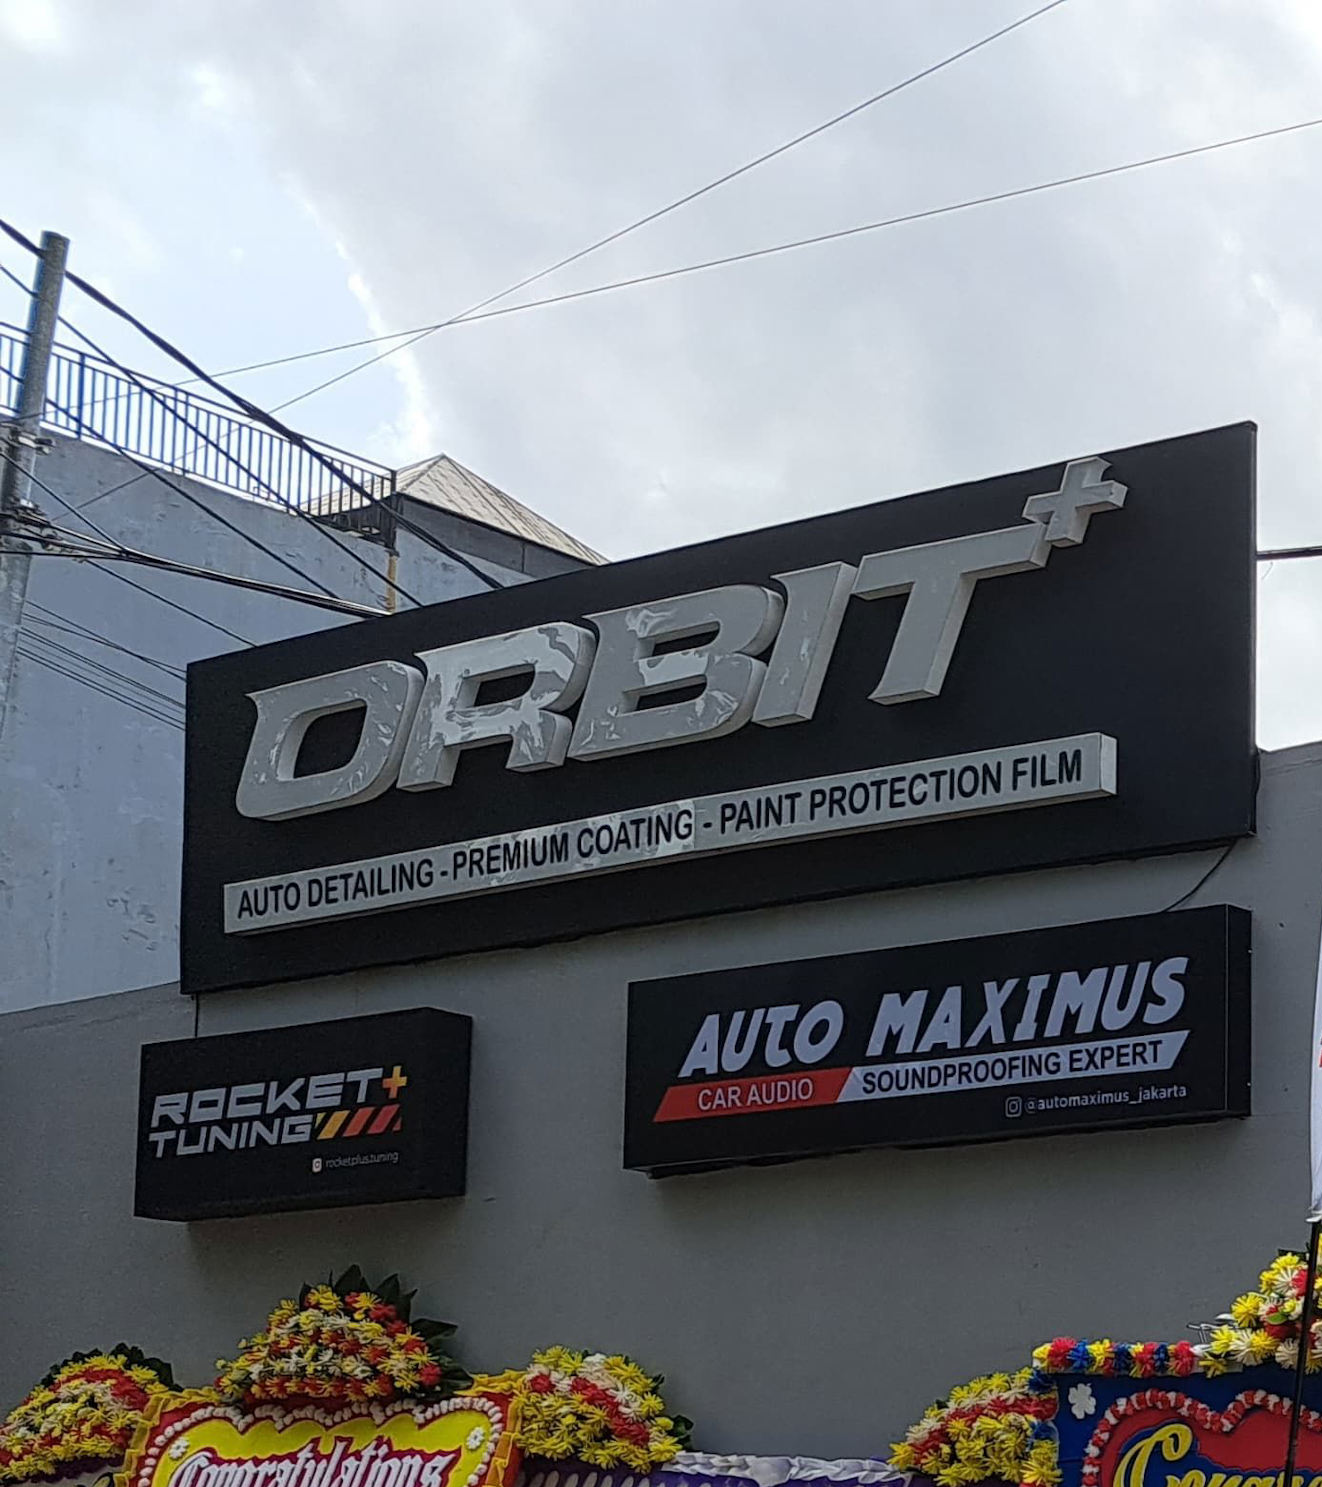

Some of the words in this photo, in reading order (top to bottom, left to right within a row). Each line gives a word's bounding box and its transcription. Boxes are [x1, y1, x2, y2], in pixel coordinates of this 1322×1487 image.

[237, 882, 299, 920] AUTO
[307, 858, 435, 908] DETAILING
[452, 832, 569, 882] PREMIUM
[577, 808, 693, 858] COATING
[720, 791, 802, 835] PAINT
[810, 760, 1001, 821] PROTECTION
[1011, 748, 1083, 792] FILM
[677, 999, 845, 1079] AUTO
[865, 956, 1190, 1057] MAXIMUS
[698, 1085, 741, 1111] CAR
[745, 1077, 814, 1106] AUDIO
[862, 1048, 1062, 1094] SOUNDPROOFING
[1068, 1038, 1164, 1072] EXPERT
[148, 1114, 313, 1159] TUNING
